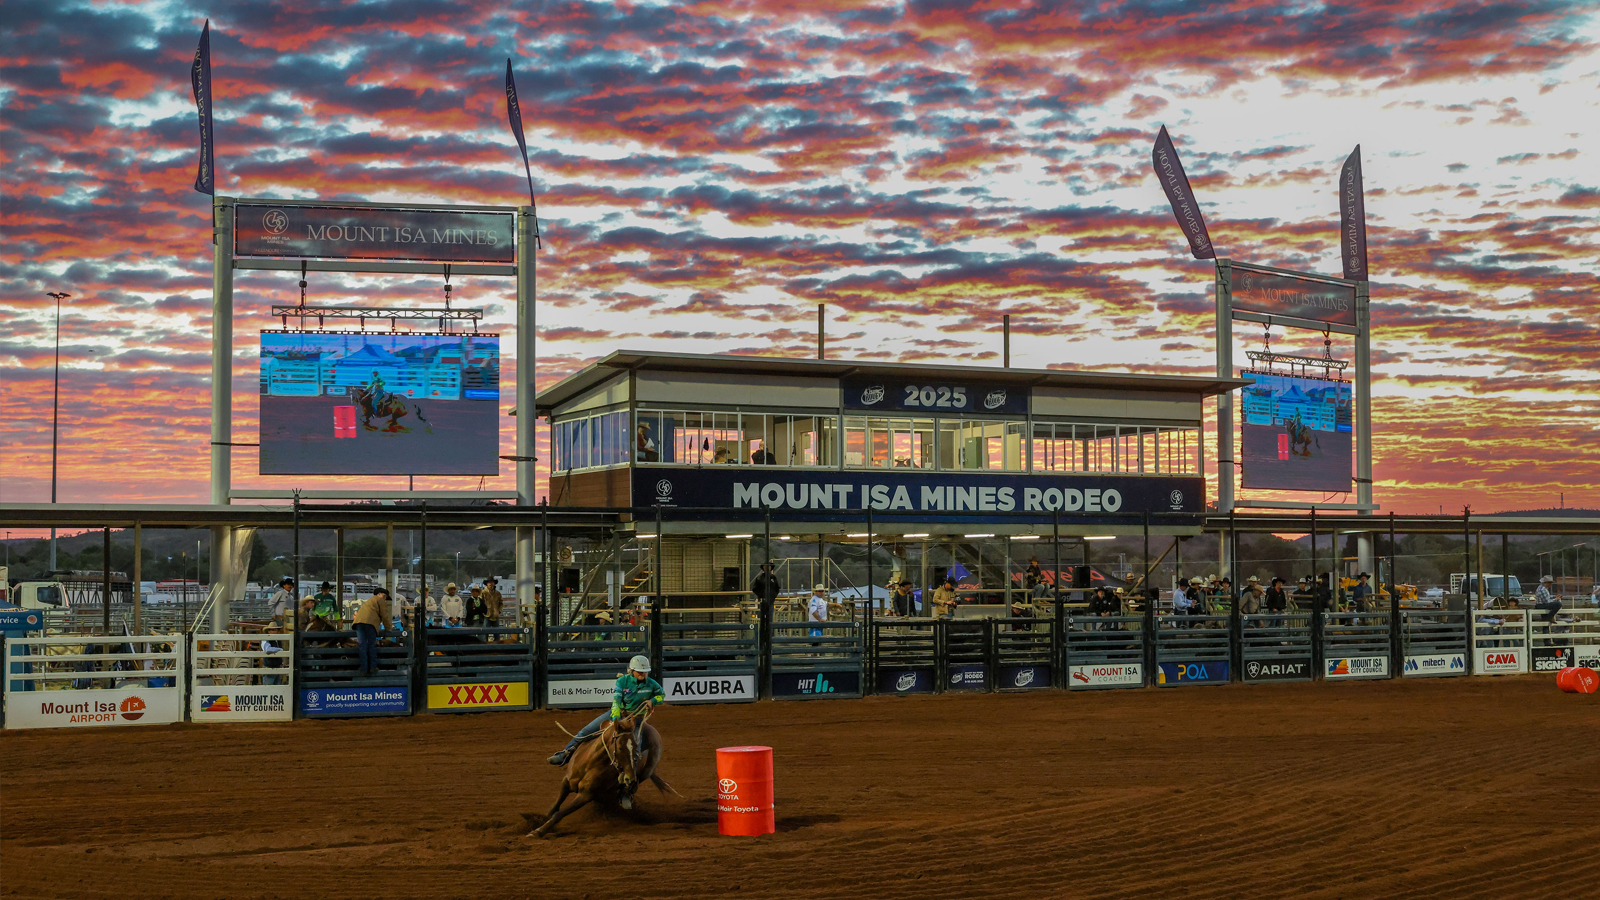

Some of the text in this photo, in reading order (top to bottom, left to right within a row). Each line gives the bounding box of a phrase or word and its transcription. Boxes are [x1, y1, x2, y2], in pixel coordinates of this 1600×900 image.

[306, 224, 498, 245] MOUNT ISA MINES
[1261, 287, 1301, 304] MOUNT
[1301, 293, 1317, 308] ISA
[1318, 297, 1349, 312] MINES
[904, 385, 967, 408] 2025
[733, 482, 1122, 513] MOUNT ISA MINES RODEO
[1350, 658, 1383, 668] MOUNT ISA
[1422, 657, 1446, 667] mitech
[1486, 653, 1517, 665] CAVA
[1535, 660, 1567, 670] SIGNS
[1092, 667, 1138, 676] MOUNT ISA
[1177, 663, 1209, 680] POA
[1260, 663, 1304, 675] ARIAT
[671, 680, 745, 696] AKUBRA
[797, 679, 815, 689] HIT
[326, 691, 403, 702] Mount Isa Mines
[447, 684, 509, 705] XXXX
[552, 688, 566, 696] Bell
[575, 687, 592, 695] Moir
[235, 694, 284, 706] MOUNT ISA
[41, 700, 116, 715] Mount Isa
[69, 713, 117, 723] AIRPORT
[734, 806, 759, 814] Toyota
